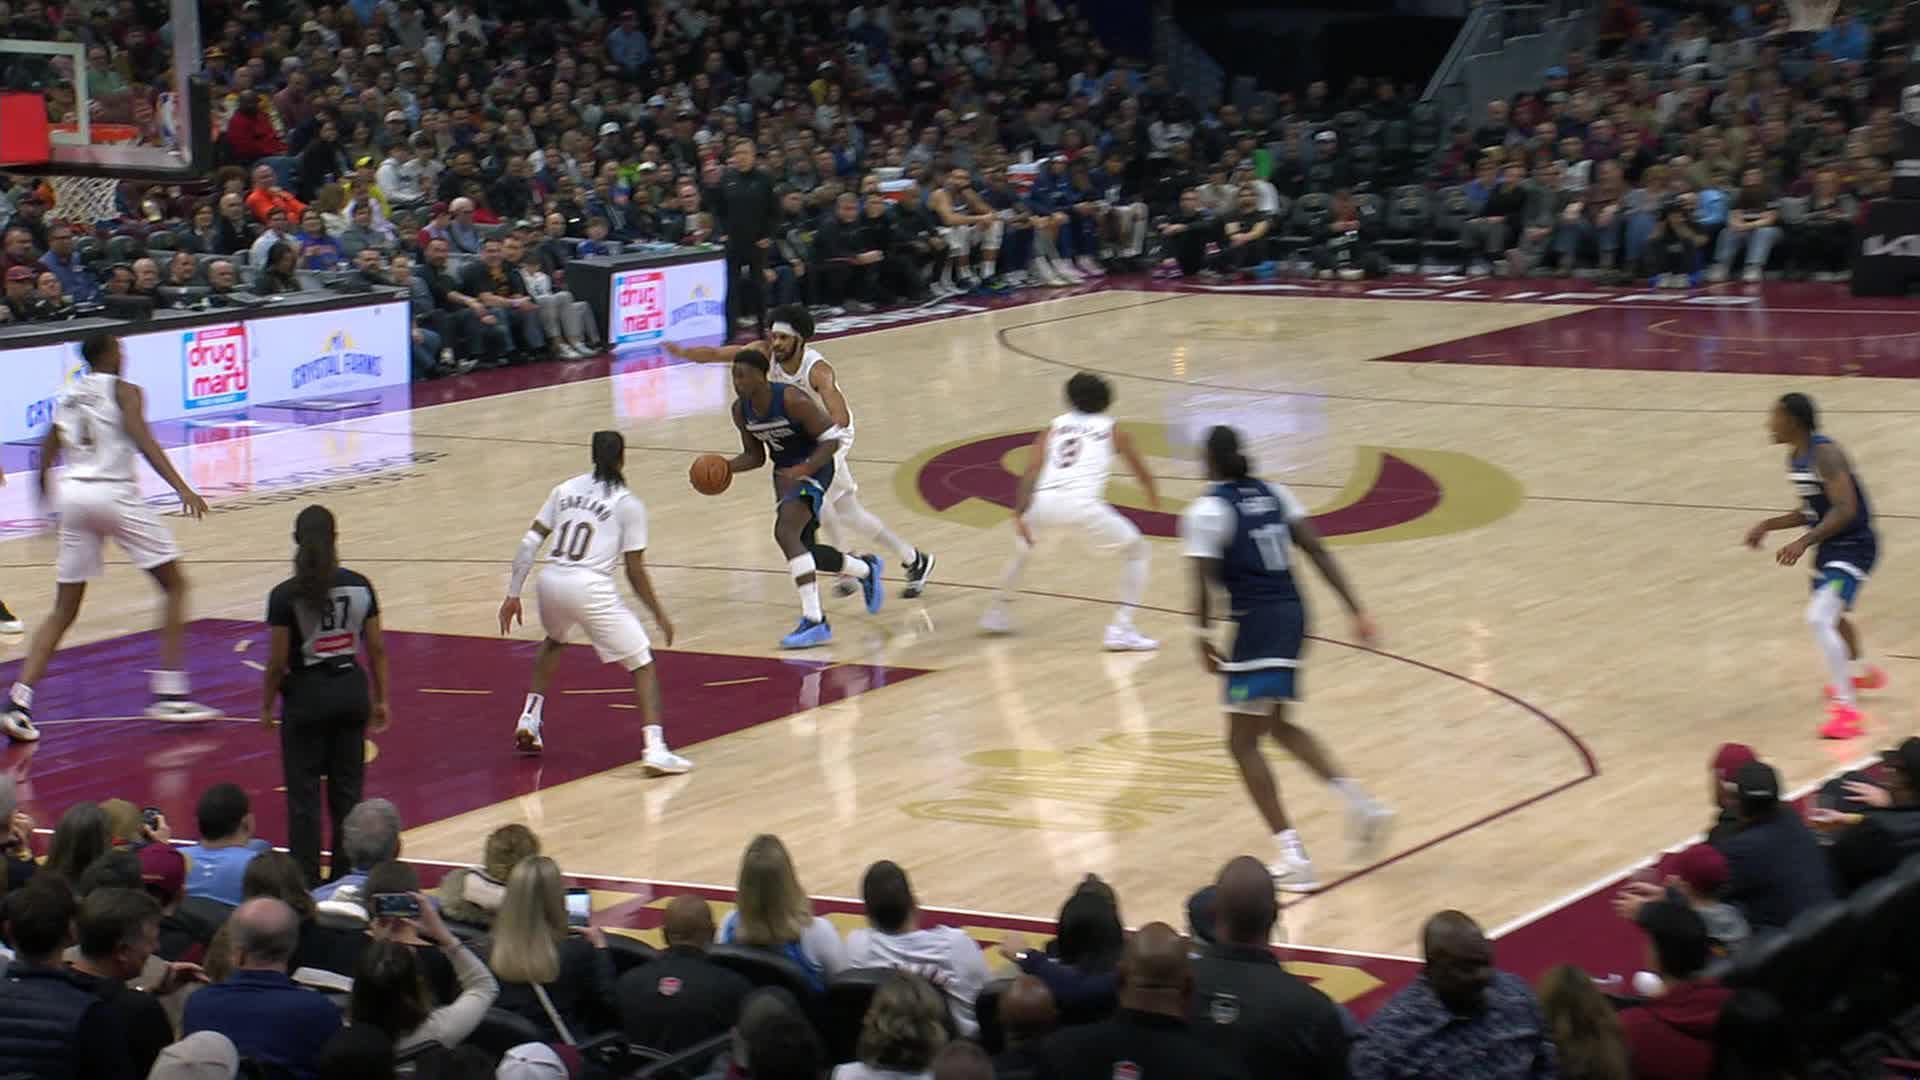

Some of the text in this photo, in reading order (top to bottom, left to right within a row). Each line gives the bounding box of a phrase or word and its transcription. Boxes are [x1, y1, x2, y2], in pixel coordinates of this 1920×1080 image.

[189, 333, 237, 371] drug
[192, 366, 247, 397] mart
[559, 494, 613, 522] GARLAND
[551, 519, 594, 561] 10
